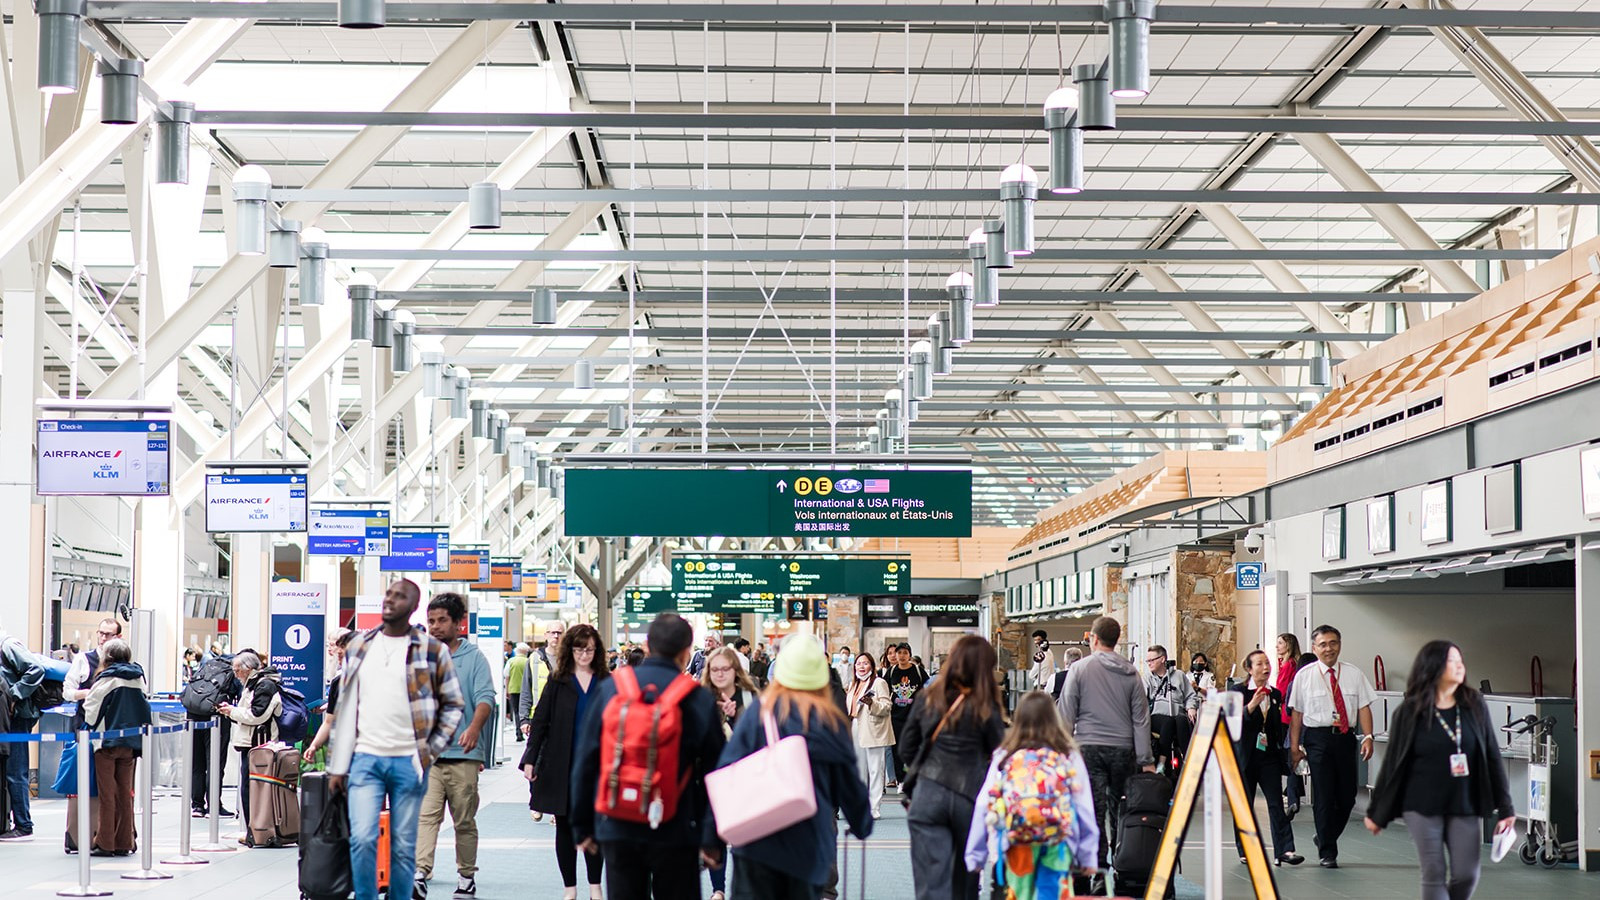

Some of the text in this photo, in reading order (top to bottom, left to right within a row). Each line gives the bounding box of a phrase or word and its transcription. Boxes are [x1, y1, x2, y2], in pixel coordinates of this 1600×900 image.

[794, 498, 924, 510] International & USA Flights
[795, 508, 953, 520] Vols internationaux et États-Unis
[795, 523, 850, 532] 美国及国际出发
[294, 628, 300, 644] 1
